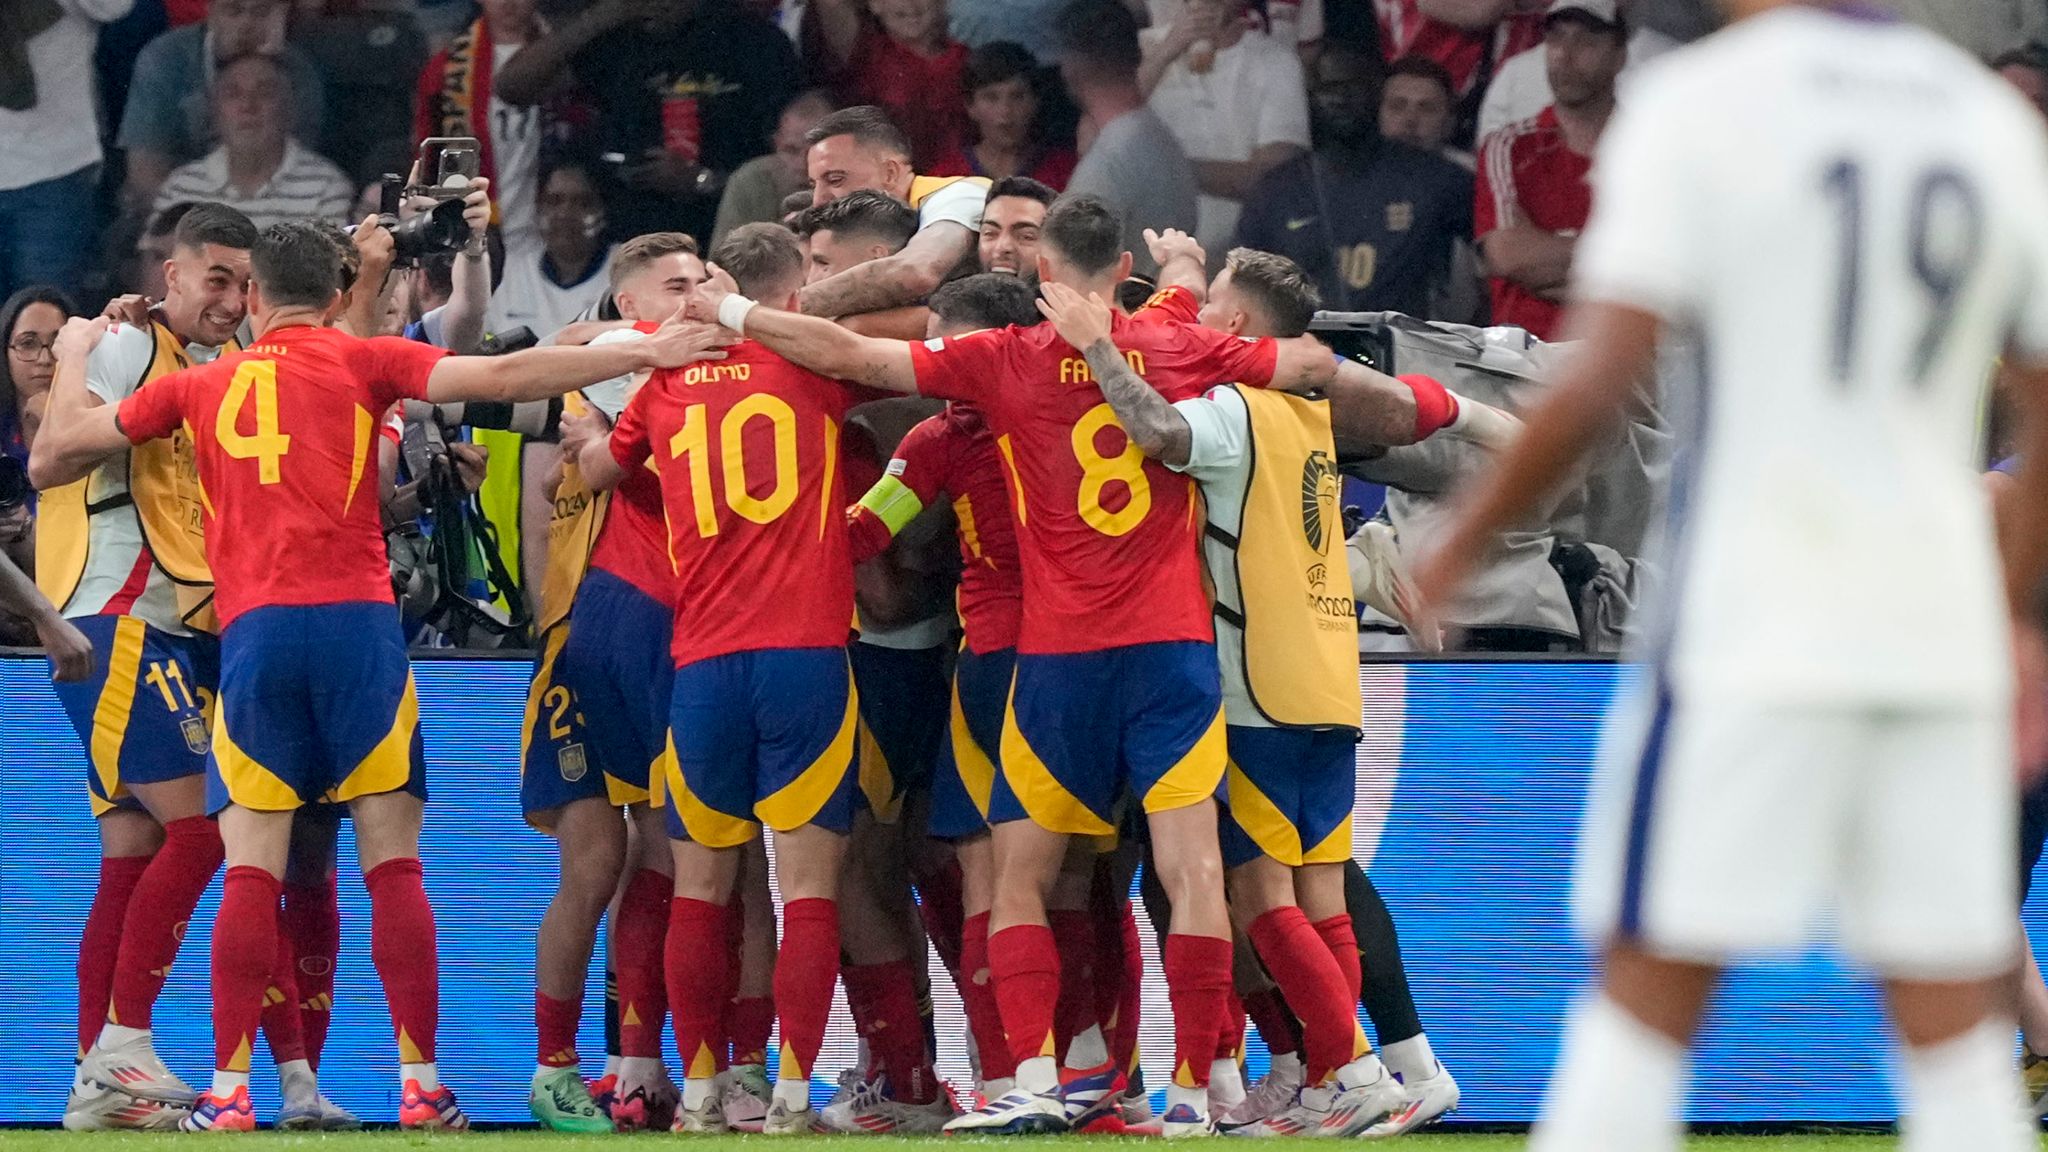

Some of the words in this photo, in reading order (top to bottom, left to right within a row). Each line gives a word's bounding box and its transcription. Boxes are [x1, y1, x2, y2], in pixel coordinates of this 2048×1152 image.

[1338, 243, 1377, 289] 10
[1821, 158, 1984, 380] 19
[684, 363, 750, 385] OLMO
[215, 359, 291, 485] 4
[669, 393, 799, 538] 10
[1071, 402, 1152, 537] 8
[145, 658, 195, 713] 11
[544, 685, 586, 740] 2
